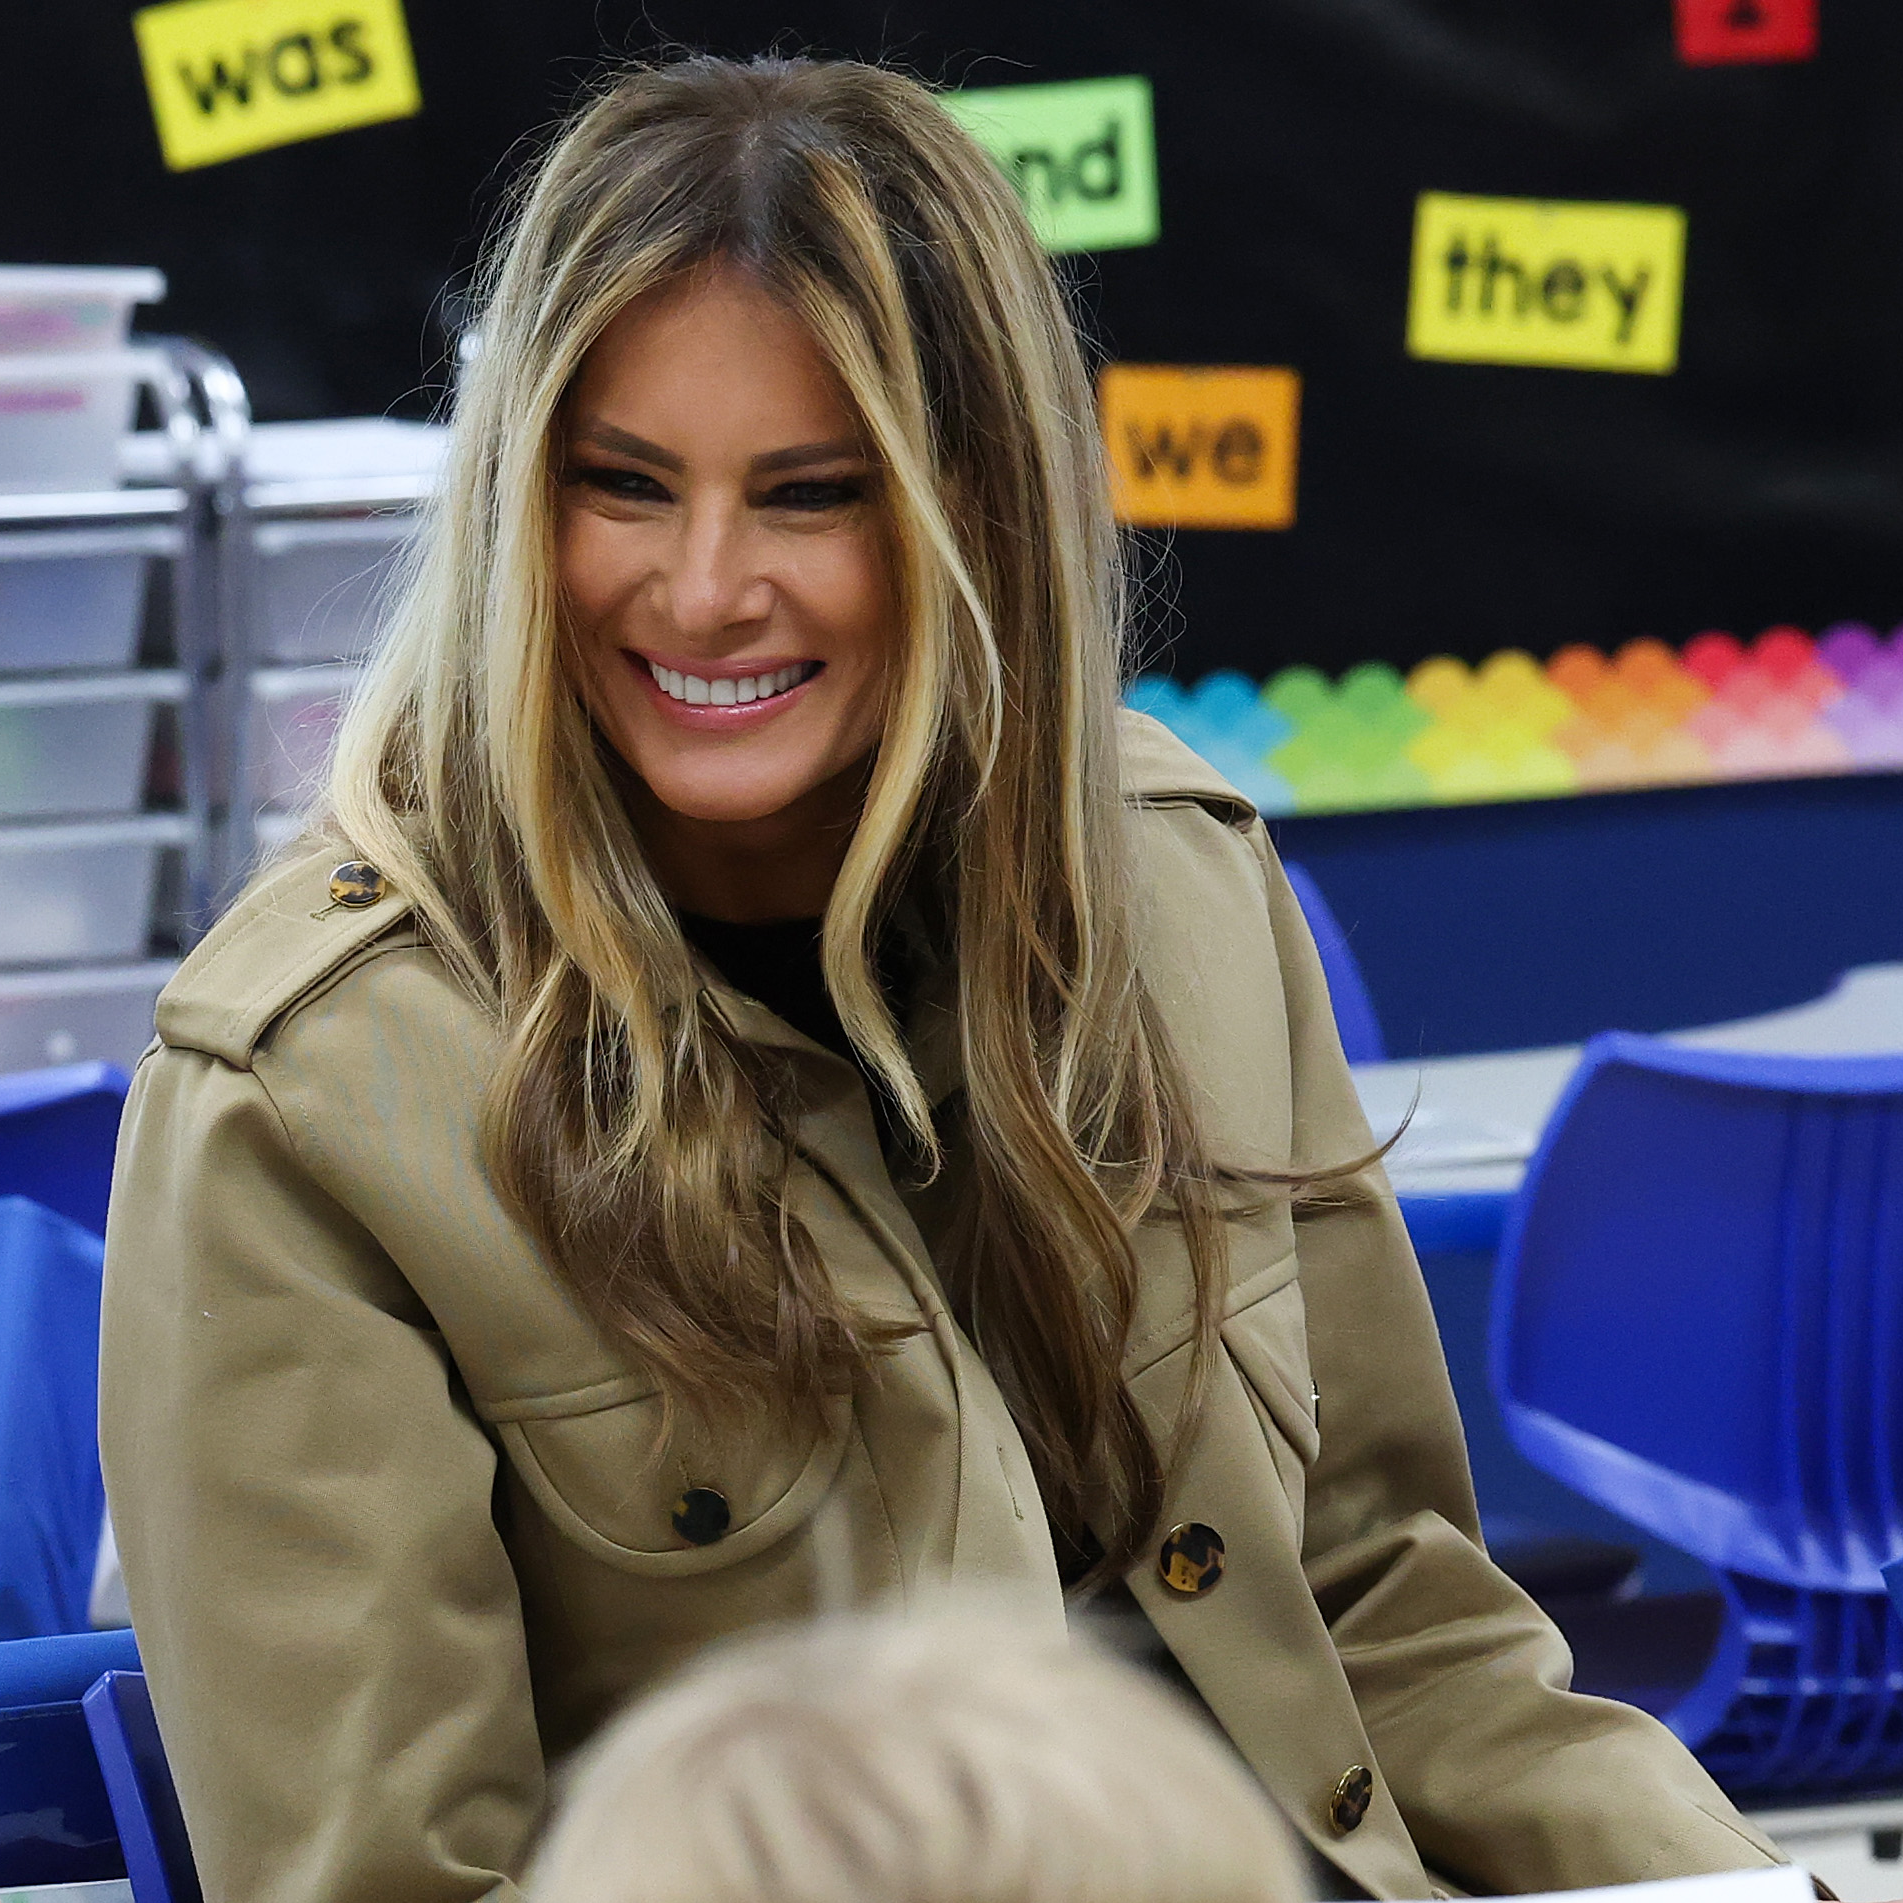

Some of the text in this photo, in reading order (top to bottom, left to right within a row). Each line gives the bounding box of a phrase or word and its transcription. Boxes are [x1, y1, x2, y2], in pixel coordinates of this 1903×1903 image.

[175, 18, 374, 117] was
[1007, 113, 1124, 204] nd
[1443, 232, 1650, 348] they
[1125, 412, 1267, 490] we
